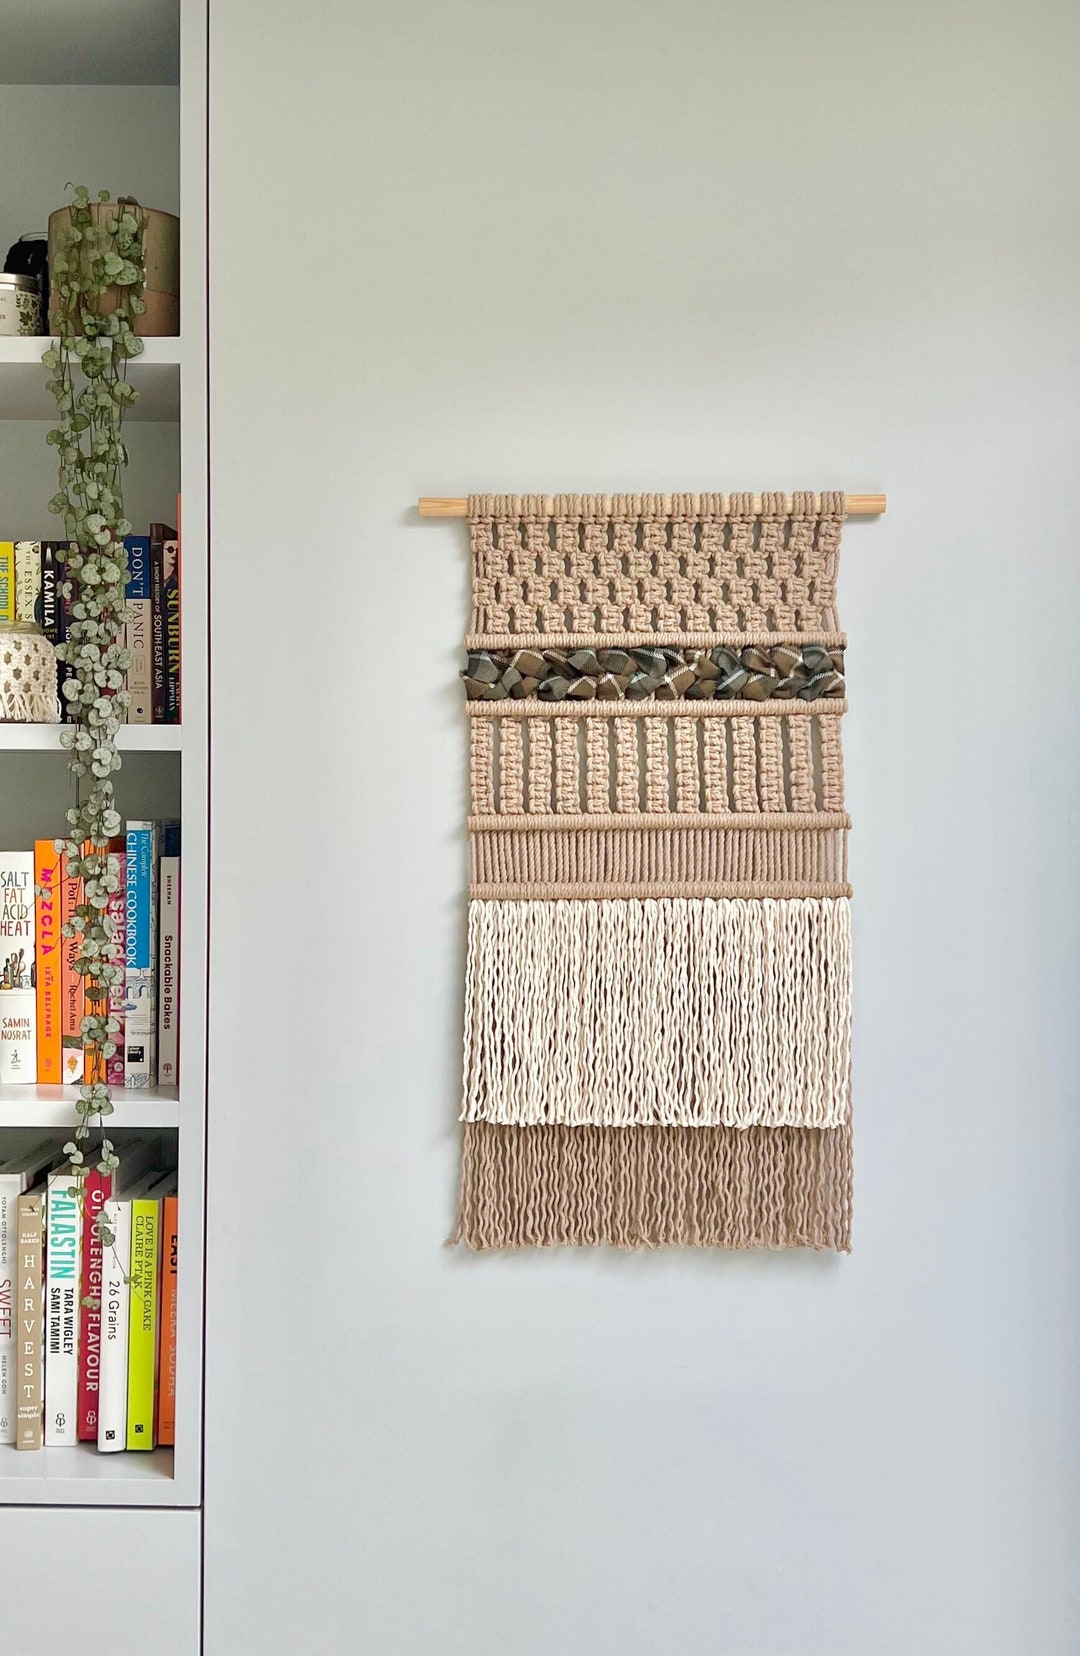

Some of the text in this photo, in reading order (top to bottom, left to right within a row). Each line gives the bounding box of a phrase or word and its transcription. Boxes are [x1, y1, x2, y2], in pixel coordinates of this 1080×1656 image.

[132, 547, 144, 596] DON'T
[0, 577, 9, 609] SCHOOL
[24, 571, 32, 607] ESSEX
[43, 570, 55, 626] KAMILA
[154, 605, 160, 613] OF
[133, 603, 144, 649] PANIC
[167, 589, 179, 673] SUNBURN
[154, 668, 163, 689] ASIA
[0, 871, 29, 887] SALT
[4, 888, 26, 903] FAT
[126, 833, 137, 966] CHINESE COOKBOOK
[2, 904, 28, 920] ACID
[0, 920, 31, 936] HEAT
[67, 941, 78, 971] Ways
[68, 985, 77, 1011] Rachel
[163, 935, 173, 1030] Snackable Bakes
[1, 1030, 32, 1040] NOSRAT
[2, 1018, 30, 1028] SAMIN
[50, 1190, 76, 1279] FALASTIN
[146, 1216, 154, 1245] LOVE
[134, 1215, 145, 1289] CLAIRE PTAK
[145, 1248, 153, 1259] IS
[108, 1281, 120, 1296] 26
[144, 1271, 153, 1298] PINK
[0, 1279, 12, 1339] SWEET
[50, 1288, 60, 1354] SAMI TAMIMI
[63, 1288, 74, 1355] TARA WIGLEY
[107, 1300, 120, 1340] Grains
[143, 1300, 153, 1331] CAKE
[23, 1255, 35, 1398] HARVEST
[86, 1313, 100, 1392] FLAVOUR
[18, 1411, 40, 1419] simple
